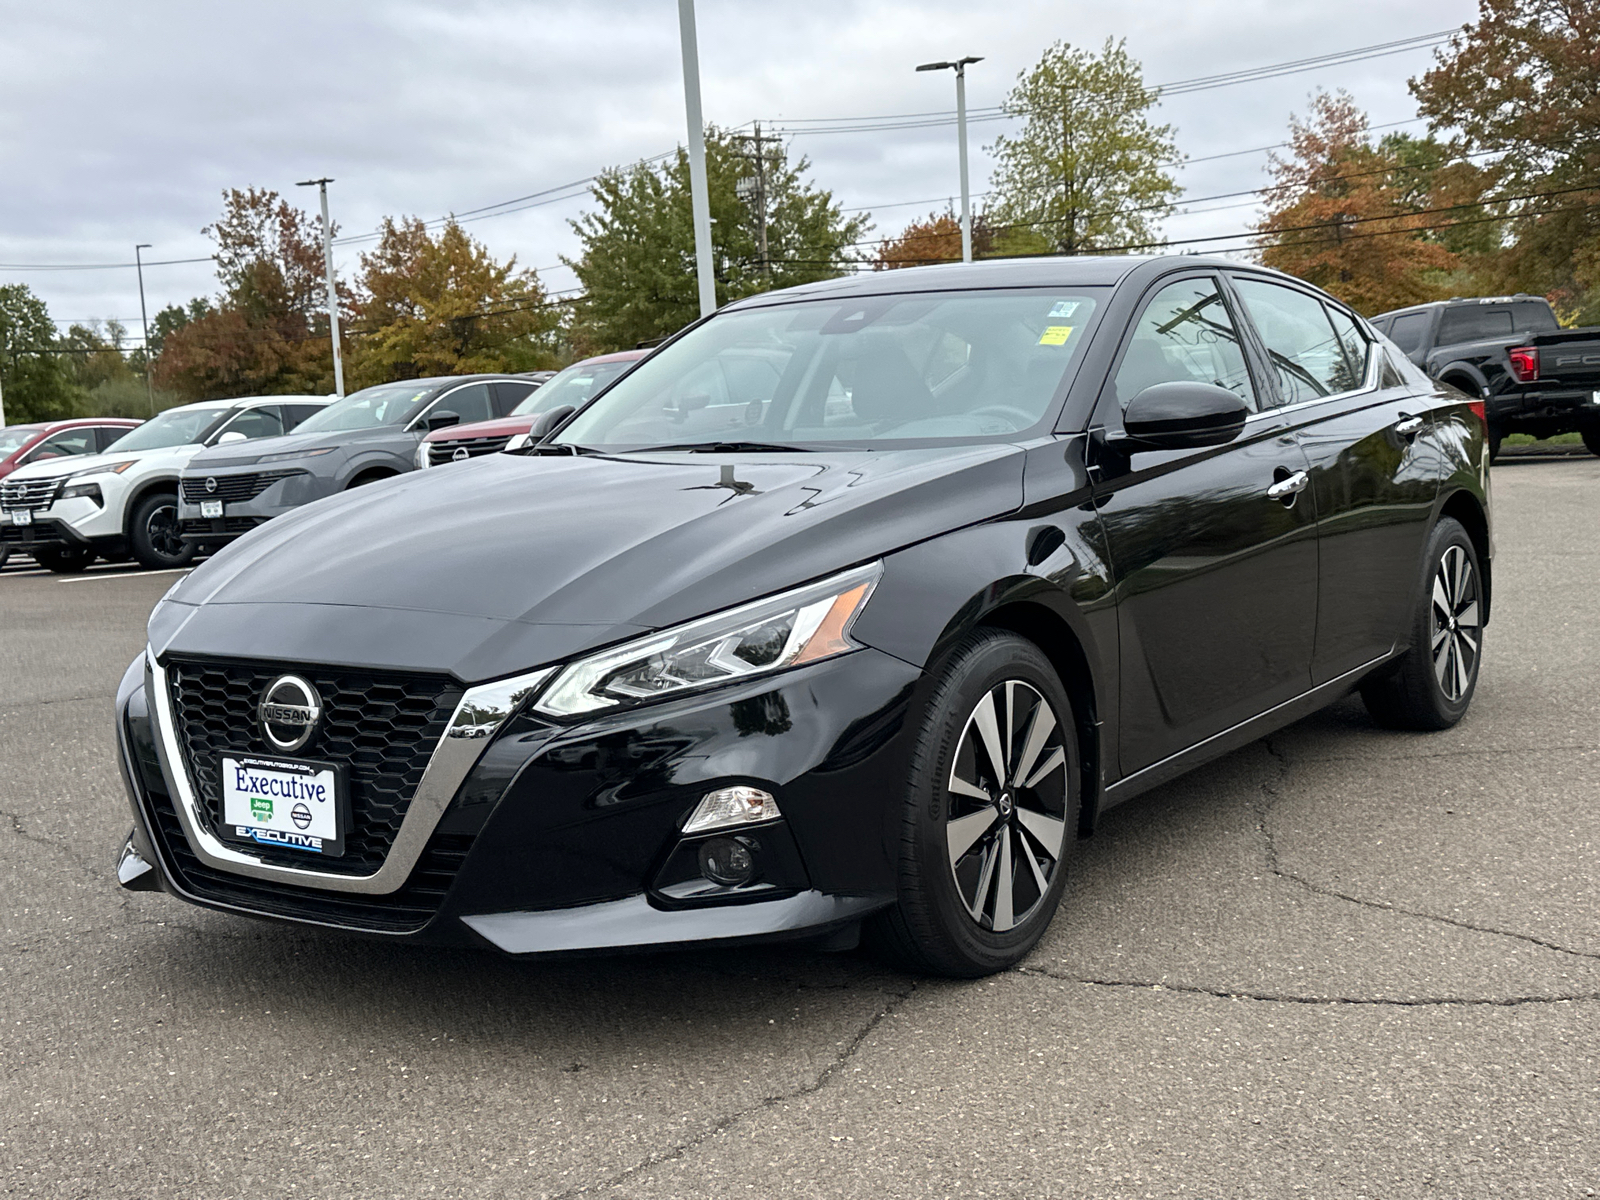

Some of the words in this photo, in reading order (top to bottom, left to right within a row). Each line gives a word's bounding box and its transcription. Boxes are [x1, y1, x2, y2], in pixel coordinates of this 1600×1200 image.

[263, 707, 311, 721] NISSAN
[928, 721, 952, 821] Continental
[235, 767, 326, 802] Executive
[253, 800, 270, 810] Jeep
[236, 826, 322, 849] EXECUTIVE
